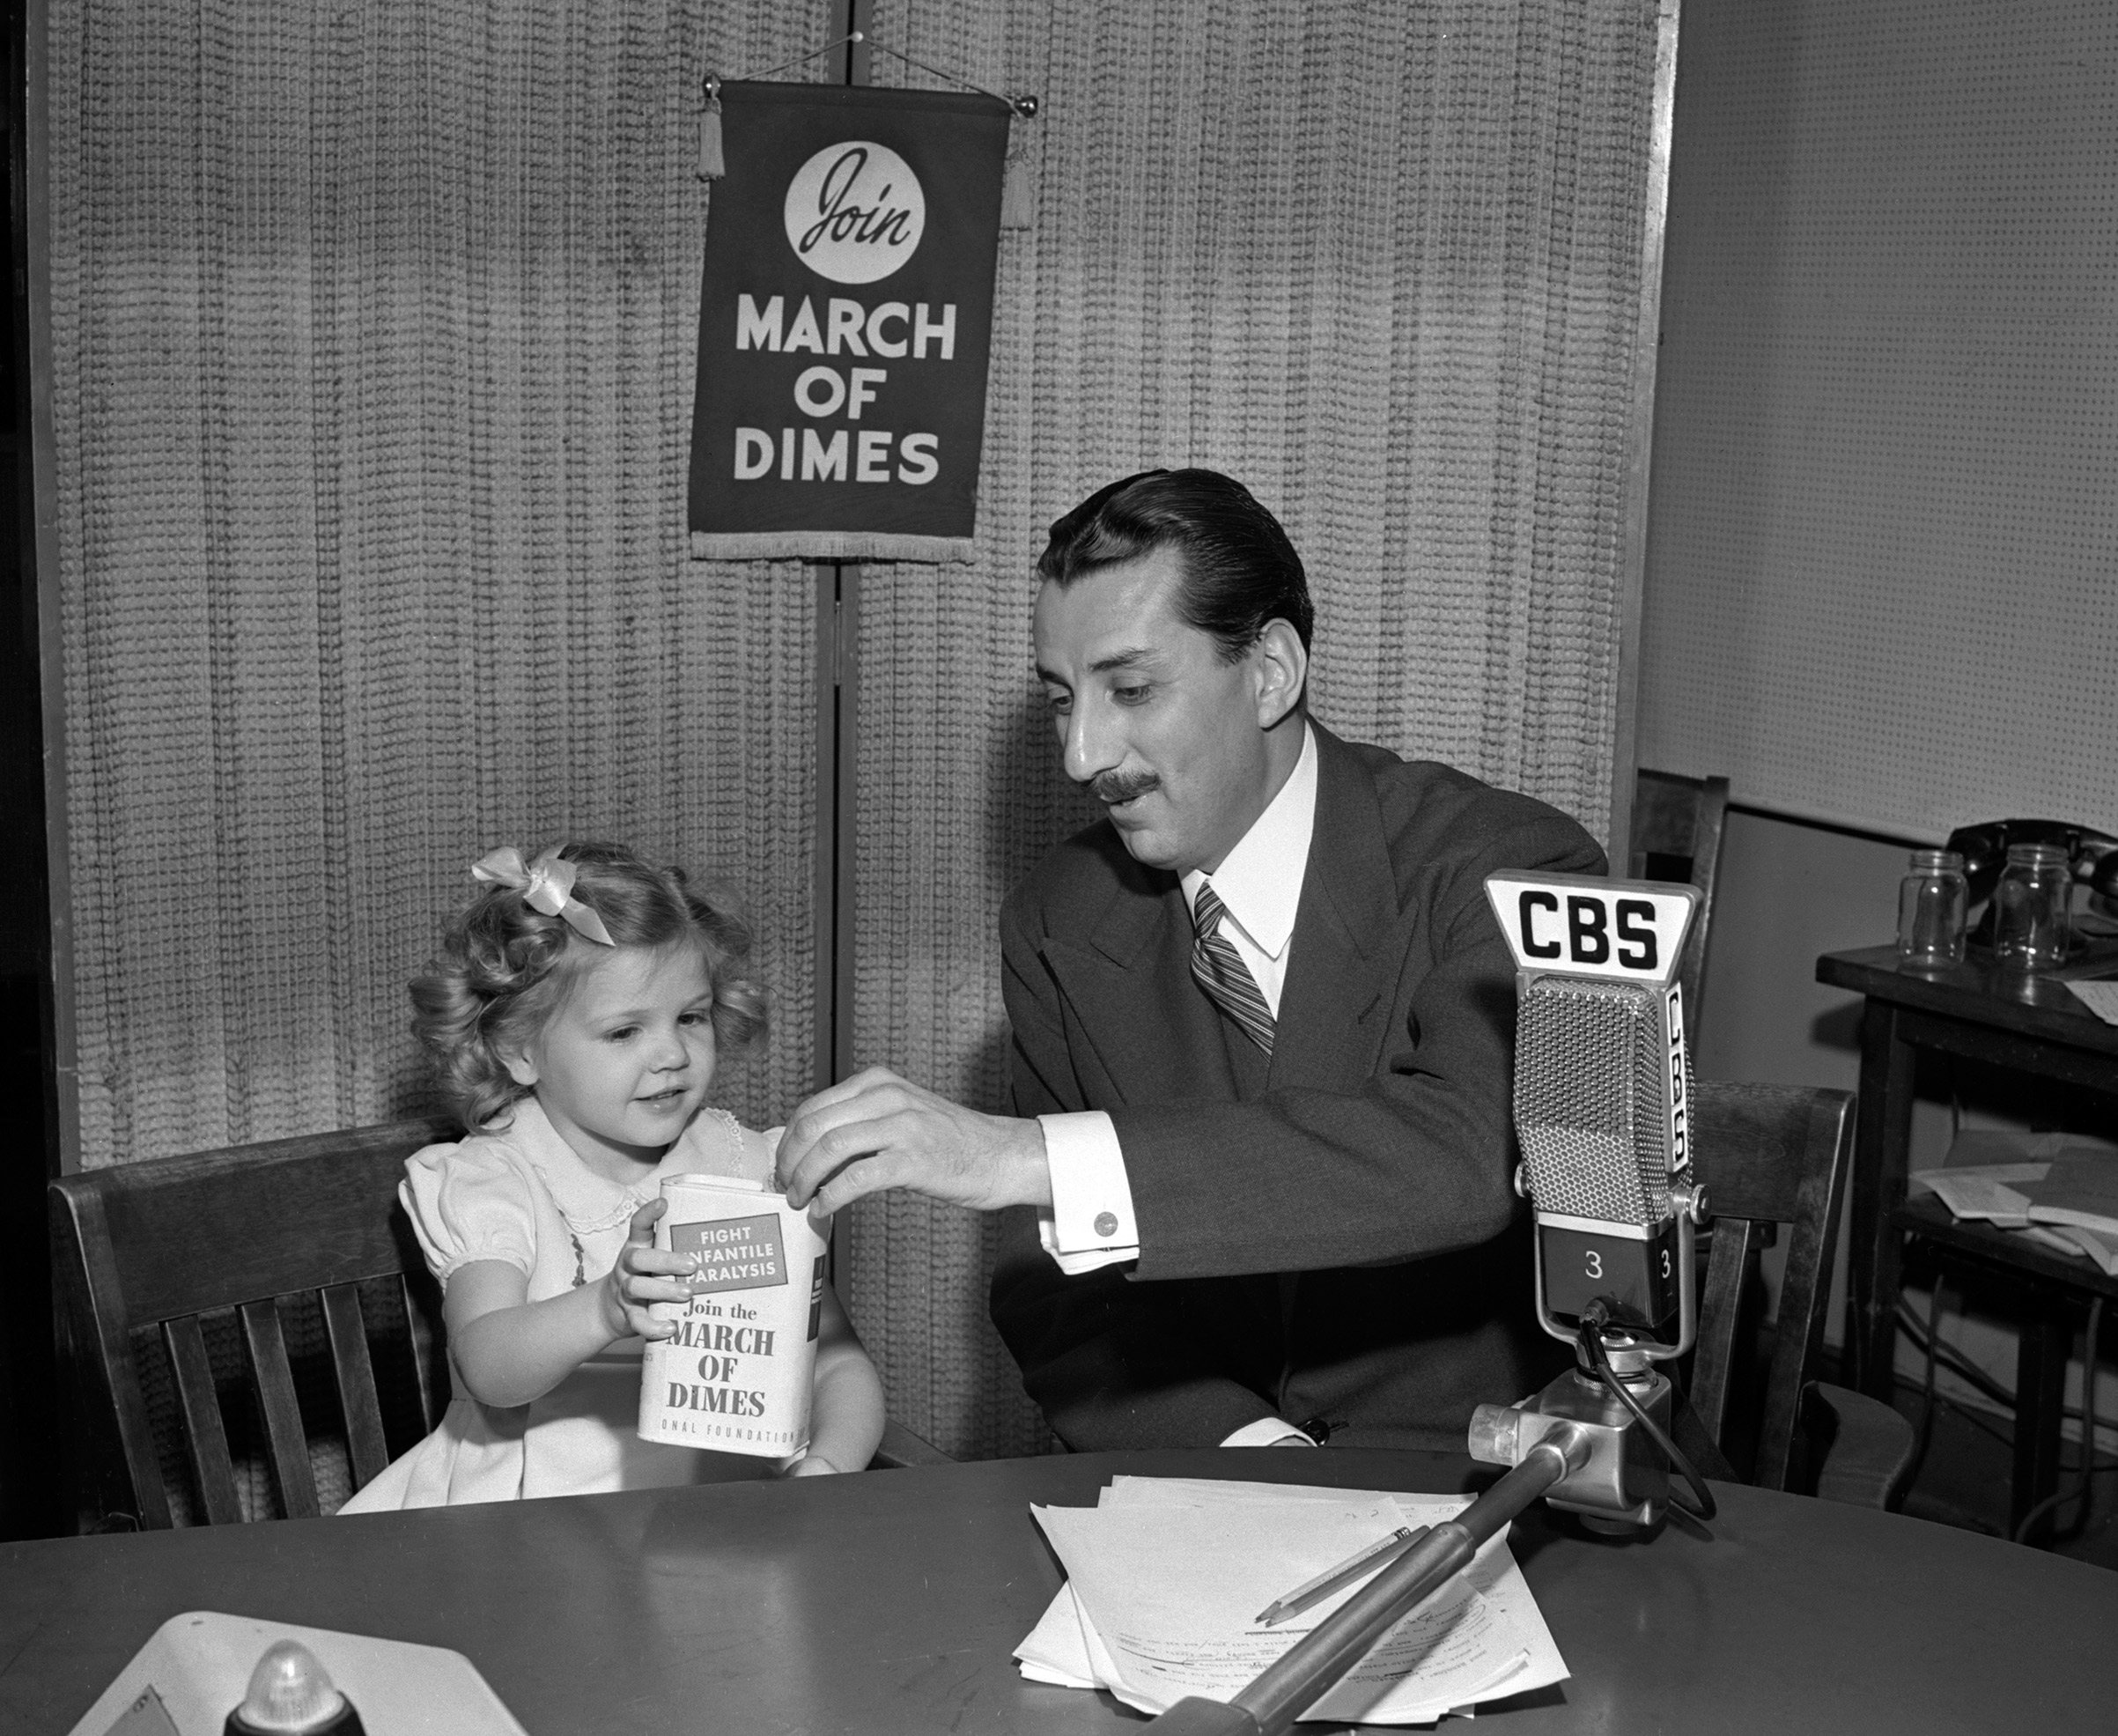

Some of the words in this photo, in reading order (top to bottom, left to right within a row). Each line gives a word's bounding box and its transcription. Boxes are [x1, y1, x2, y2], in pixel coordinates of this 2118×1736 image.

[798, 147, 911, 254] Join
[735, 293, 957, 360] MARCH
[793, 365, 887, 419] OF
[734, 426, 940, 485] DIMES
[1518, 890, 1657, 970] CBS
[1669, 991, 1686, 1163] CBS
[684, 1243, 774, 1264] NFANTILE
[700, 1226, 751, 1245] FIGHT
[1584, 1250, 1604, 1279] 3
[1661, 1248, 1671, 1279] 3
[683, 1297, 722, 1318] Join
[730, 1304, 757, 1320] the
[665, 1319, 776, 1357] MARCH
[697, 1355, 738, 1383] OF
[666, 1382, 765, 1418] DIMES
[706, 1423, 794, 1444] FOUNDATION
